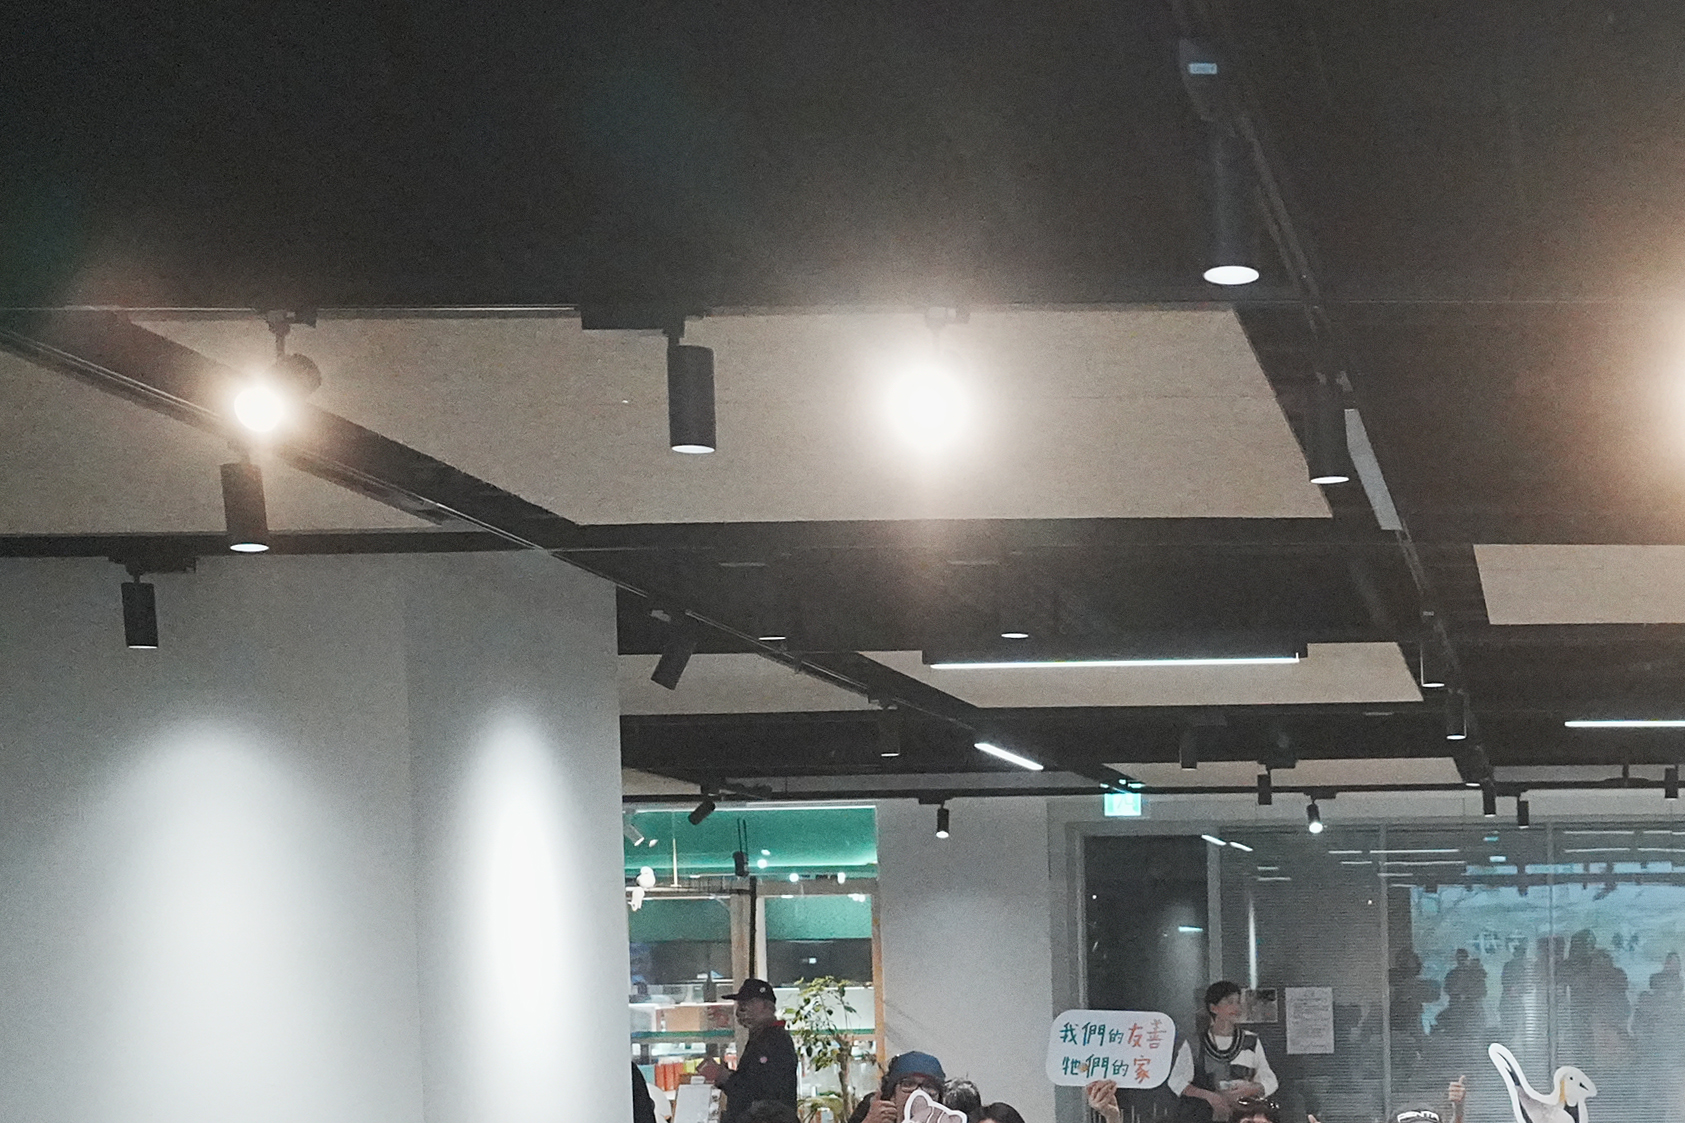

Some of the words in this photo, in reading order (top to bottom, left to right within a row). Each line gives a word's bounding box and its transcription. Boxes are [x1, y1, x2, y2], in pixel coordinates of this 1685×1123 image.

[1060, 1019, 1167, 1049] 我們的友善
[1062, 1054, 1151, 1084] 牠們的家
